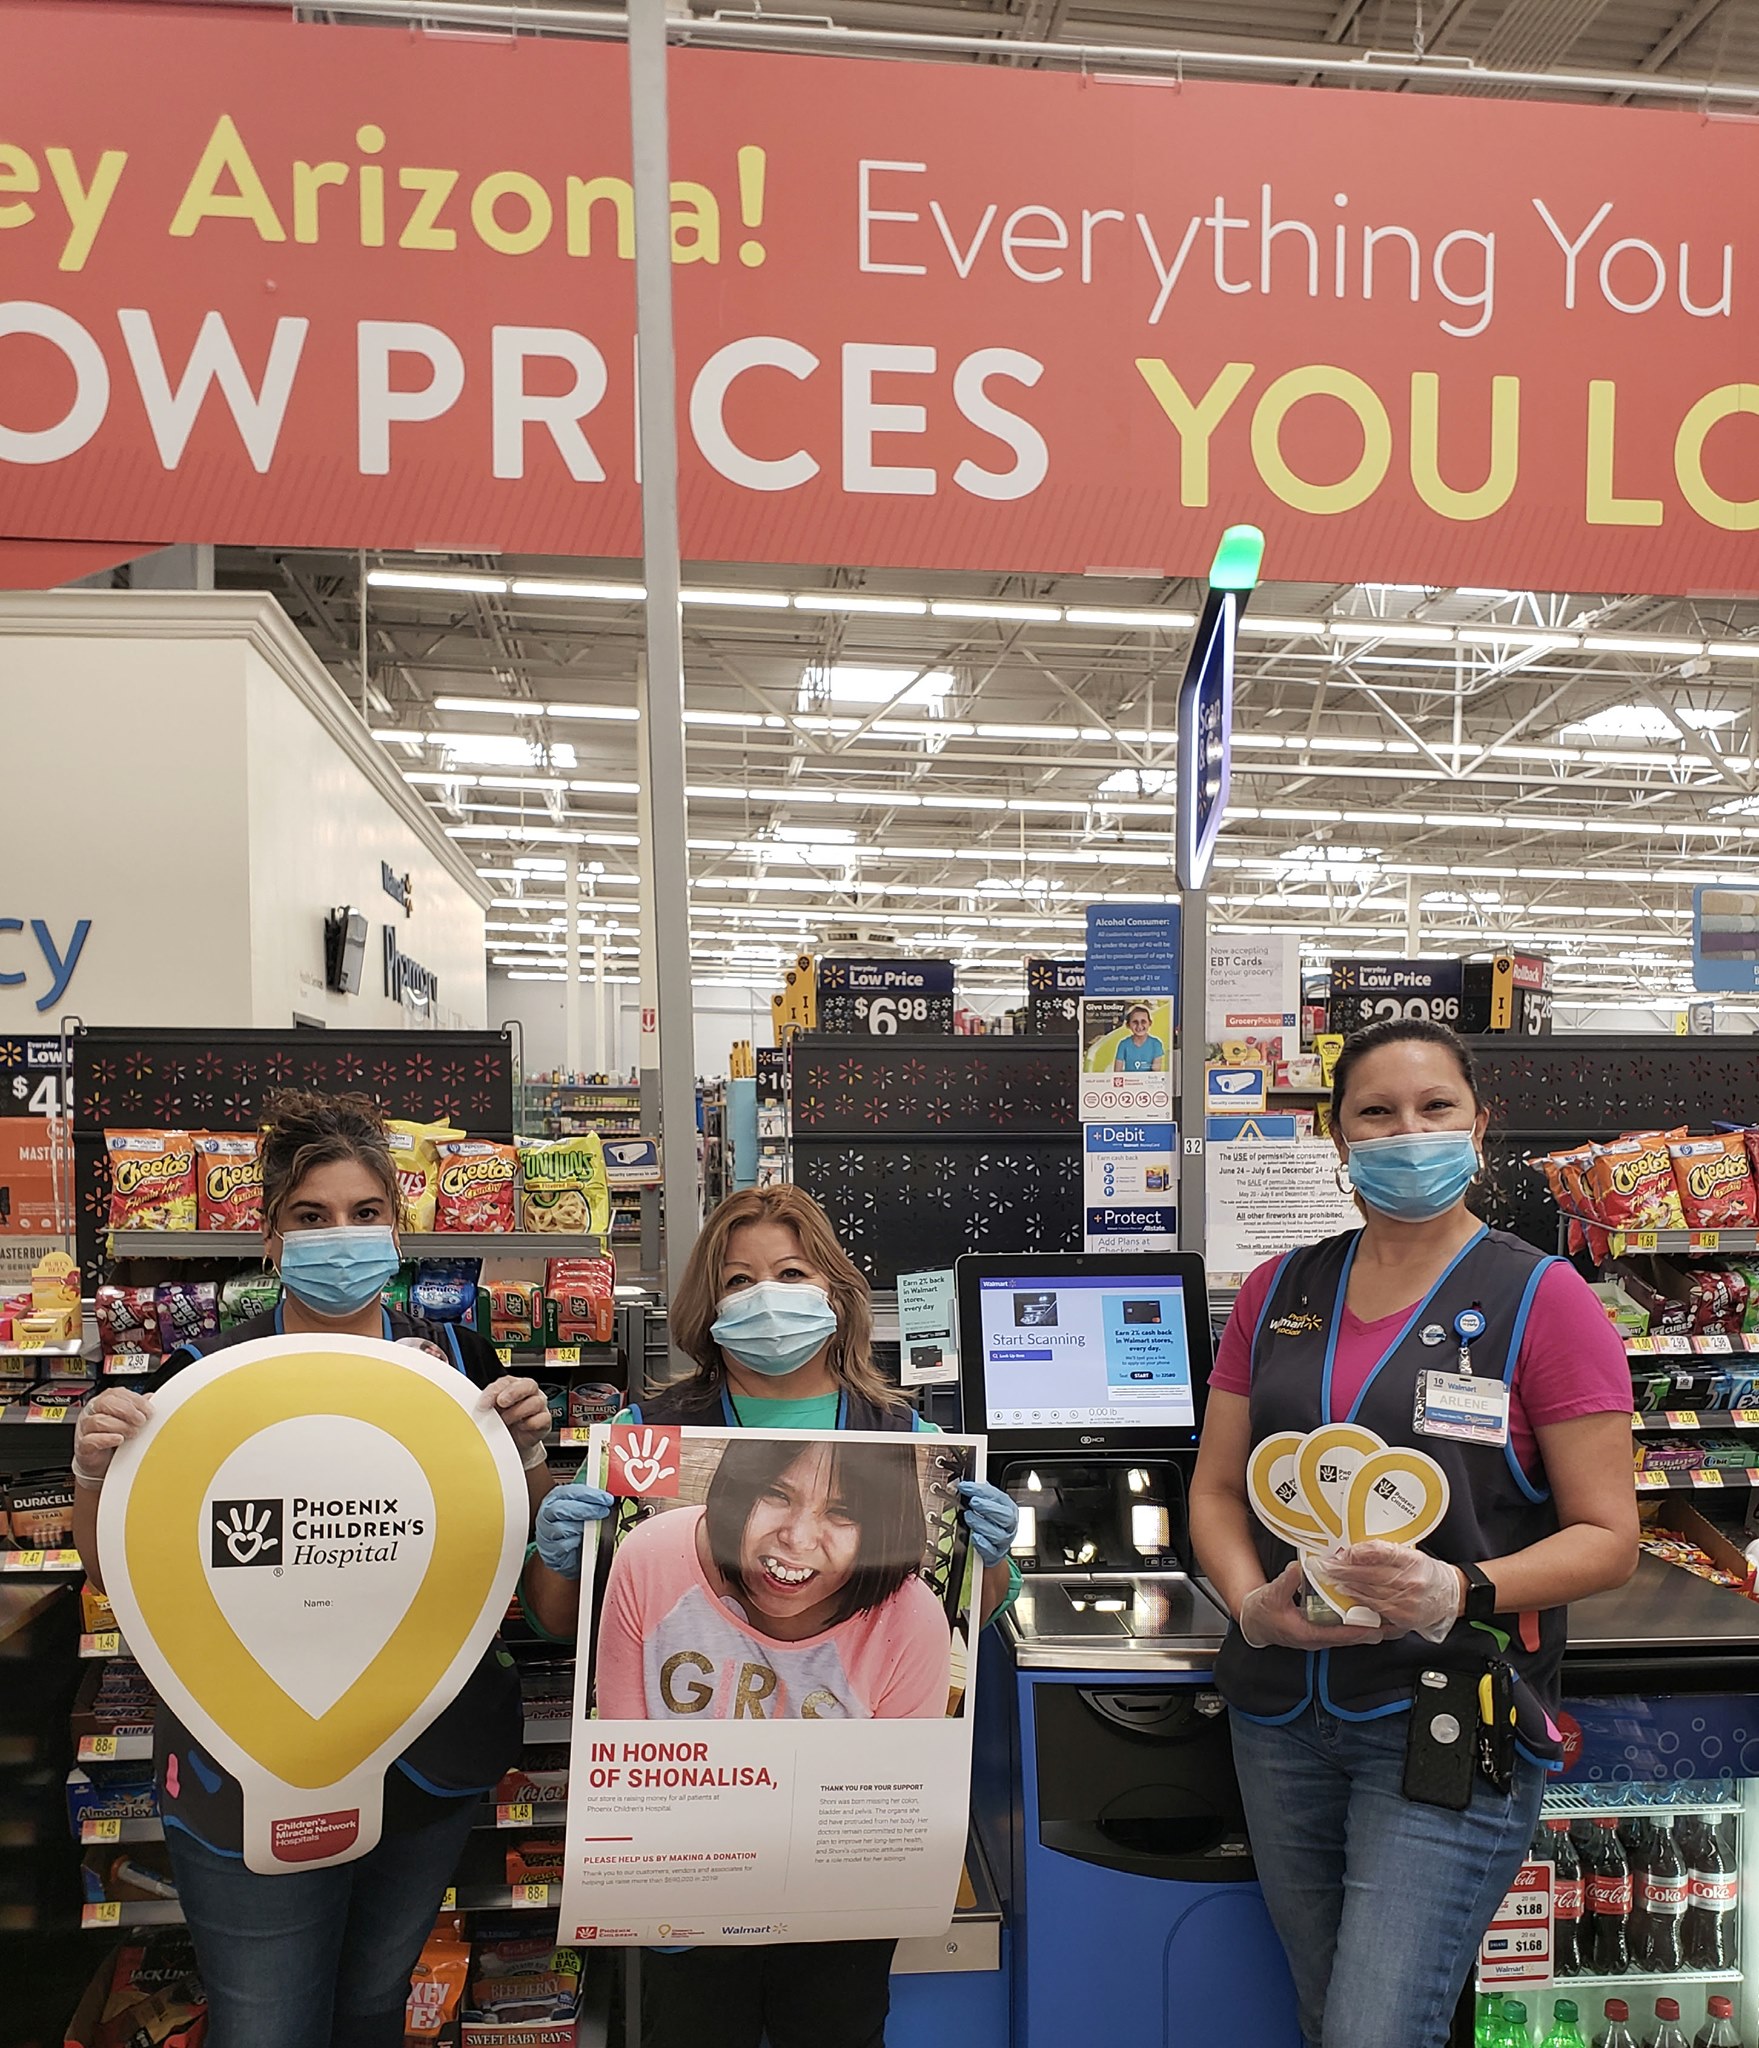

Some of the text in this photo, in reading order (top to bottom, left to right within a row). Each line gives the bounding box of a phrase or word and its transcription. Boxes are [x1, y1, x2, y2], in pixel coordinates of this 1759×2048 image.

[169, 114, 766, 268] Arizona!
[858, 160, 1494, 337] Everything
[1532, 199, 1731, 317] You
[1135, 358, 1520, 521] YOU
[1095, 918, 1170, 926] Alcohol Consumer:
[1231, 946, 1268, 956] accepting
[1210, 956, 1262, 966] EBT Cards
[850, 972, 924, 986] Low Price
[1243, 969, 1273, 977] grocery
[1360, 972, 1431, 986] Low Price
[1233, 1153, 1248, 1161] USE
[1258, 1152, 1295, 1161] permissible
[116, 1152, 192, 1194] Cheetos
[440, 1158, 518, 1197] Cheetos
[1612, 1151, 1671, 1195] Cheetos
[1689, 1154, 1749, 1200] Cheetos
[1098, 1238, 1115, 1246] Add
[1118, 1237, 1138, 1245] Plans
[1640, 1234, 1654, 1247] 1.68
[1702, 1234, 1716, 1247] 1.68
[911, 1286, 938, 1294] Walmart
[993, 1333, 1085, 1347] Start Scanning
[561, 1349, 576, 1360] 3.24
[1448, 1383, 1476, 1393] Walmart
[1440, 1395, 1488, 1410] ARLENE
[293, 1498, 398, 1517] PHOENIX
[292, 1519, 424, 1540] CHILDREN'S
[292, 1541, 399, 1568] Hospital
[304, 1599, 334, 1608] Name:
[591, 1743, 708, 1762] IN HONOR
[589, 1767, 778, 1790] OF SHONALISA,
[646, 1795, 667, 1803] money
[687, 1793, 712, 1801] patients
[78, 1806, 131, 1821] Almond
[587, 1805, 612, 1813] Phoenix
[614, 1804, 644, 1812] Children's
[276, 1818, 326, 1831] Children's
[276, 1820, 356, 1839] Miracle Network
[276, 1834, 320, 1847] Hospitals
[584, 1856, 617, 1864] PLEASE
[713, 1852, 757, 1860] DONATION
[1644, 1885, 1681, 1902] Coke
[1692, 1882, 1729, 1898] Coke
[1516, 1904, 1542, 1916] $1.88
[722, 1925, 771, 1935] Walmart
[1516, 1940, 1542, 1952] $1.68
[557, 1951, 576, 1961] BIG
[555, 1959, 577, 1969] BAG
[1495, 1965, 1524, 1973] Walmart
[466, 2031, 572, 2045] SWEET BABY RAY'S
